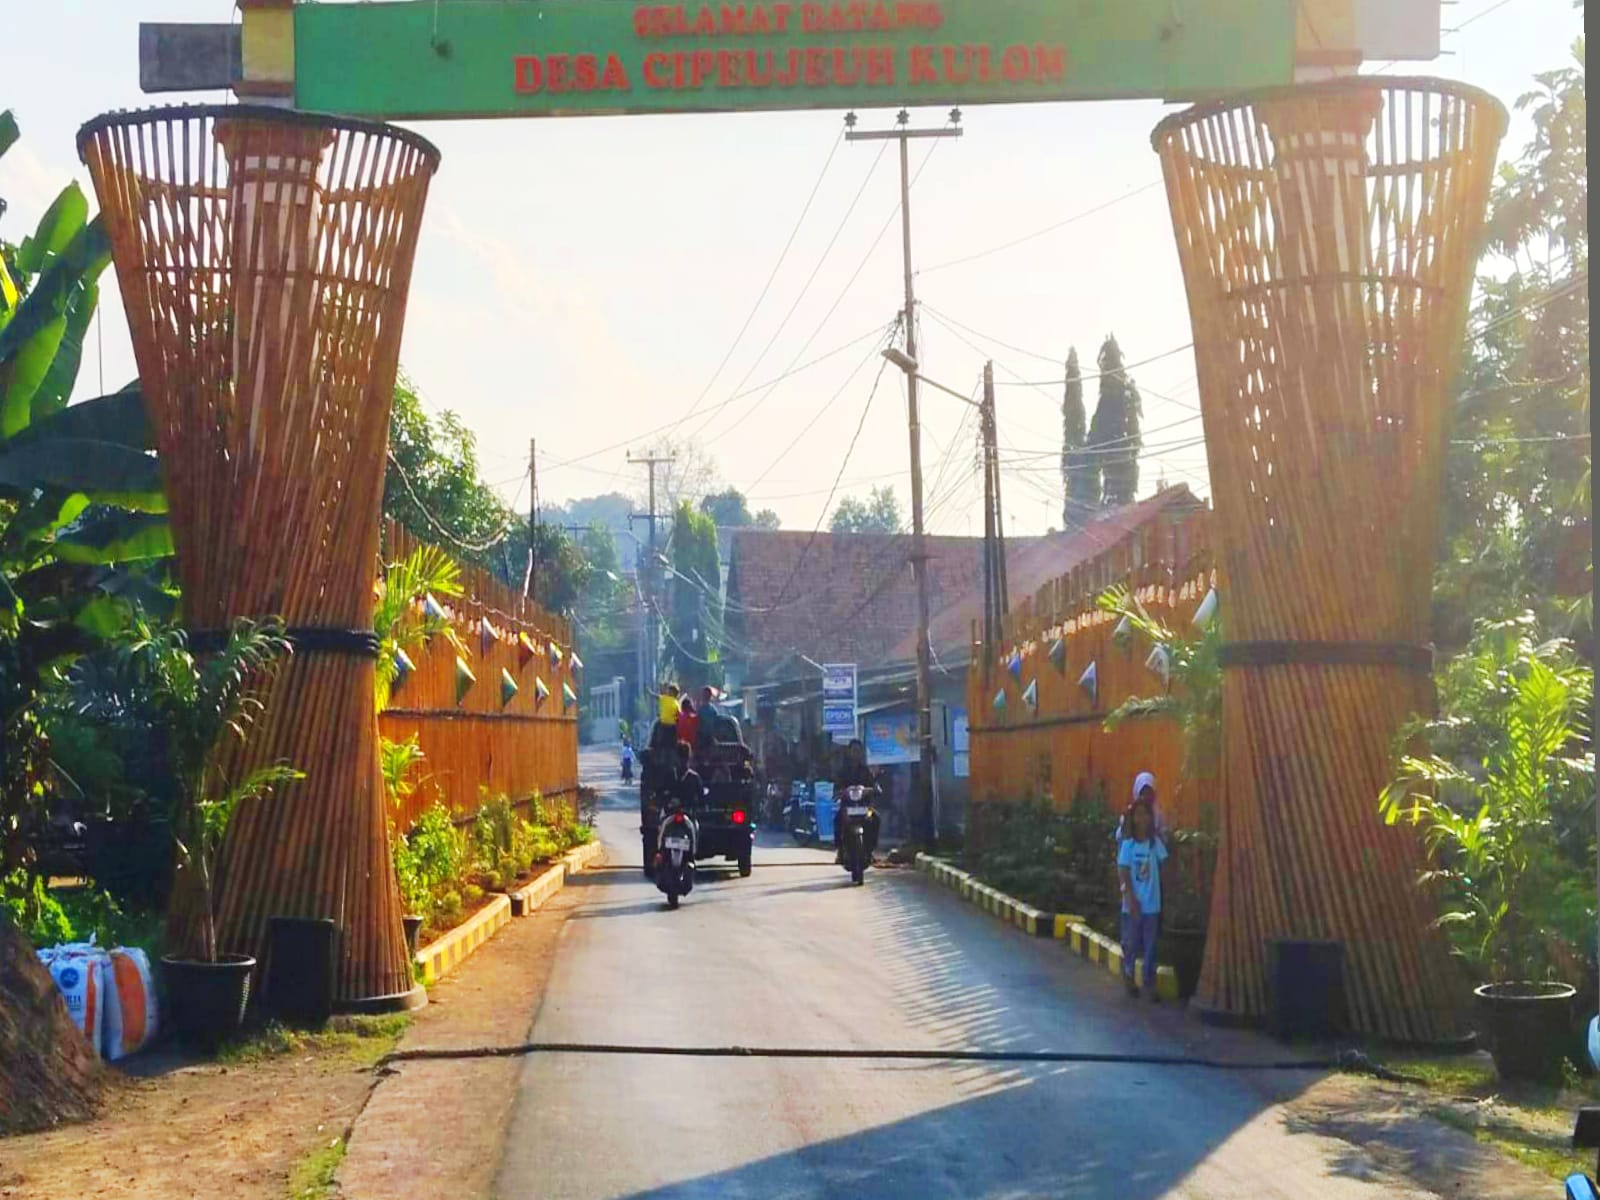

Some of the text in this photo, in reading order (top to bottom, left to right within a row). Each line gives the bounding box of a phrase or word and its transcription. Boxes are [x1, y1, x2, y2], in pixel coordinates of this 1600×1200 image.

[633, 3, 793, 37] SELAMAT
[513, 42, 1067, 94] DESA CIPEUJEUH KULON
